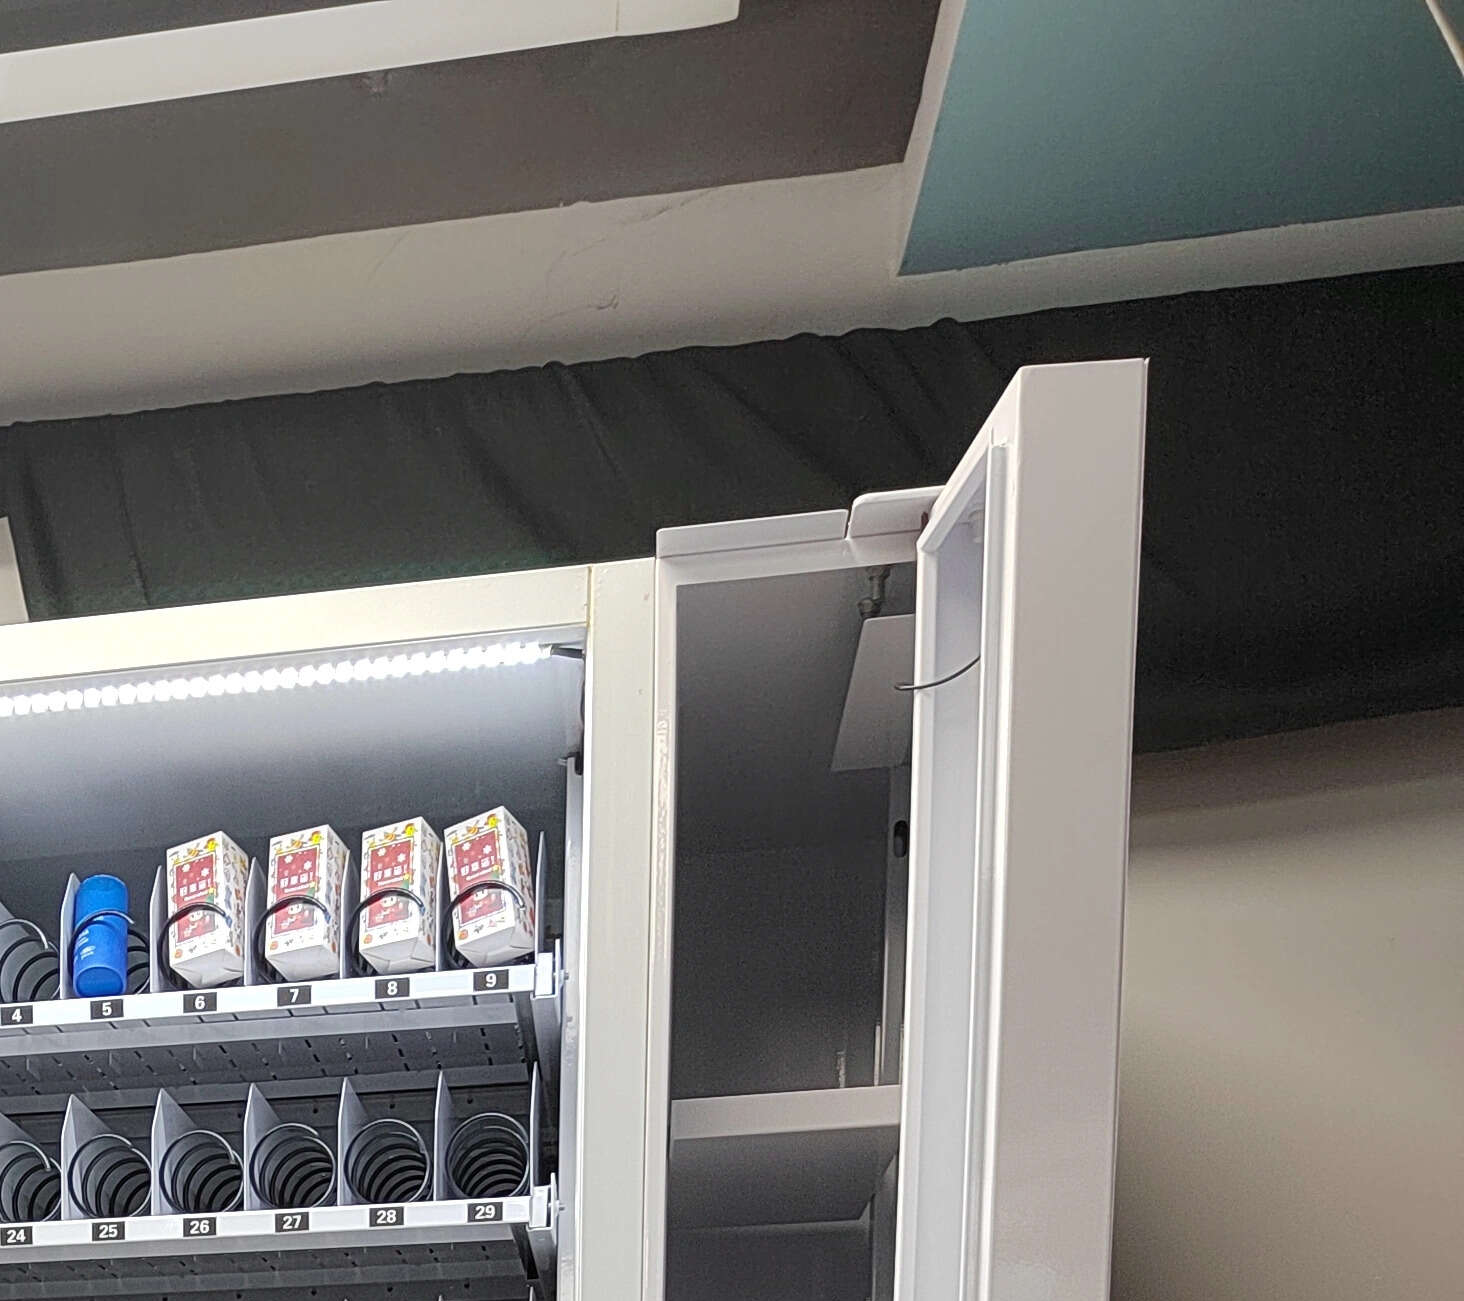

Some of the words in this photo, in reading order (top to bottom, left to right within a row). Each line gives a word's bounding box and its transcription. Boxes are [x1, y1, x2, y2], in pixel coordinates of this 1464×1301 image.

[11, 1008, 23, 1023] 4
[102, 1001, 113, 1017] 5
[194, 995, 206, 1010] 6
[289, 988, 300, 1003] 7
[386, 980, 398, 996] 8
[485, 972, 497, 988] 9
[6, 1228, 27, 1244] 24
[98, 1224, 118, 1239] 25
[189, 1219, 210, 1235] 26
[282, 1214, 302, 1230] 27
[376, 1209, 397, 1224] 28
[474, 1204, 496, 1220] 29
